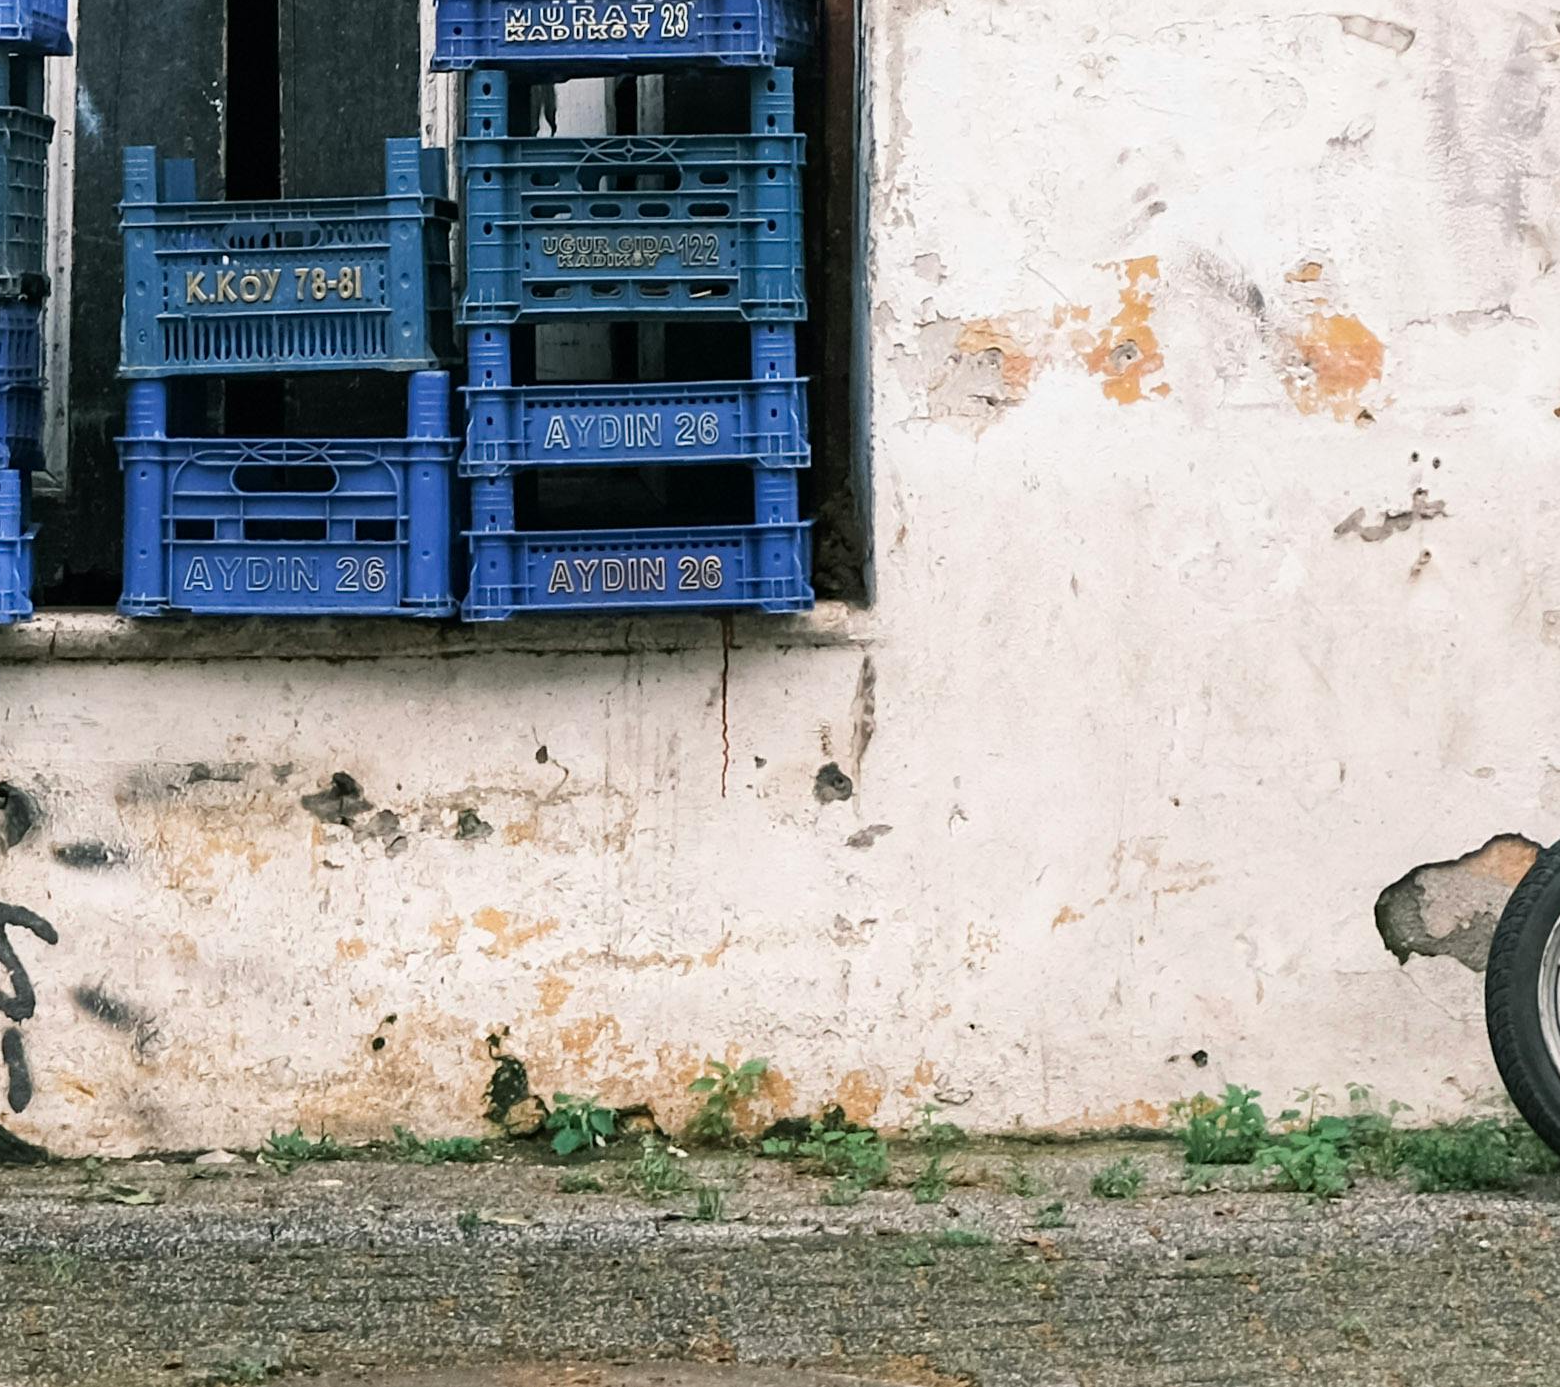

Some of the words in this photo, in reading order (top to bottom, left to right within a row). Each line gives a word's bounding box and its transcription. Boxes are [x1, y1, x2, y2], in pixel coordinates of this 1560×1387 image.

[504, 4, 655, 27] MURAT
[660, 2, 689, 38] 23
[616, 235, 675, 254] GIDA
[677, 233, 720, 267] 122
[294, 265, 363, 301] 78-81
[543, 413, 662, 450] AYDIN
[674, 412, 719, 446] 26
[183, 556, 320, 592] AYDIN
[335, 556, 387, 593] 26
[547, 556, 667, 594] AYDIN
[677, 554, 723, 590] 26
